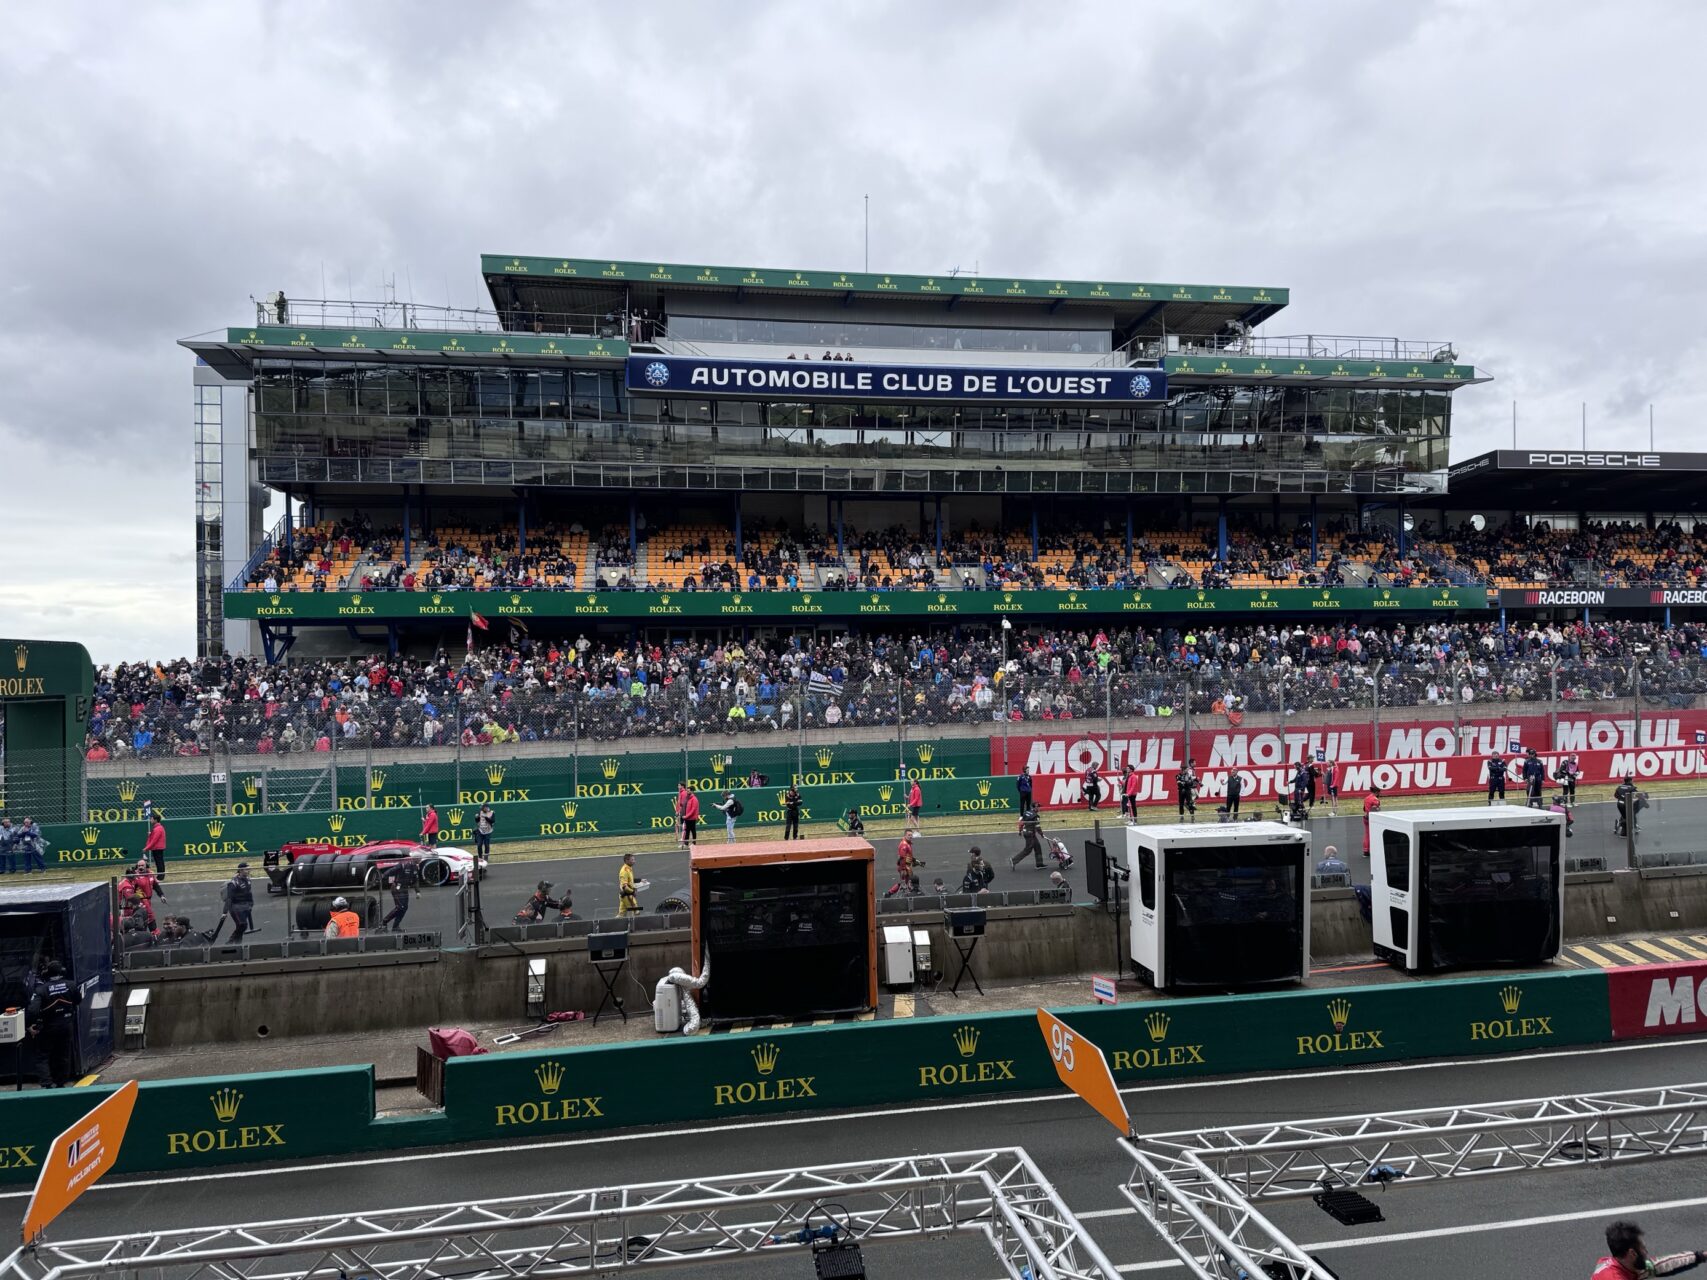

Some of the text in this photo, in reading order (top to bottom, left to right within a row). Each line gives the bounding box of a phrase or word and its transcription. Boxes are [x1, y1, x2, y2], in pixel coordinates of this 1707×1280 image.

[691, 367, 1112, 394] AUTOMOBILE CLUB DE L'OUEST
[1448, 458, 1489, 478] ORSCHE
[1529, 453, 1661, 467] PORSCHE
[1538, 590, 1605, 604] RACEBORN
[1663, 590, 1707, 604] RACEBO
[257, 607, 294, 615] ROLEX
[339, 607, 375, 615] ROLEX
[419, 606, 455, 614] ROLEX
[499, 606, 533, 614] ROLEX
[722, 605, 753, 613] ROLEX
[860, 604, 891, 612] ROLEX
[928, 604, 957, 612] ROLEX
[1386, 724, 1527, 760] MOTUL
[1557, 719, 1686, 753] MOTUL
[1026, 737, 1182, 775] MOTUL
[1208, 730, 1361, 768] MOTUL
[1342, 762, 1452, 791] MOTUL
[459, 789, 530, 804] ROLEX
[576, 782, 644, 798] ROLEX
[338, 795, 412, 811] ROLEX
[960, 798, 1010, 811] ROLEX
[540, 821, 599, 835] ROLEX
[651, 815, 707, 828] ROX
[58, 848, 124, 862] ROLEX
[184, 840, 248, 856] ROLEX
[404, 935, 417, 944] Box
[1470, 1016, 1553, 1041] ROLEX
[1052, 1023, 1074, 1071] 95
[1297, 1030, 1384, 1056] ROLEX
[1113, 1044, 1205, 1071] ROLEX
[919, 1060, 1015, 1086] ROLEX
[714, 1076, 817, 1106] ROLEX
[495, 1096, 604, 1127] ROLEX
[168, 1123, 286, 1154] ROLEX
